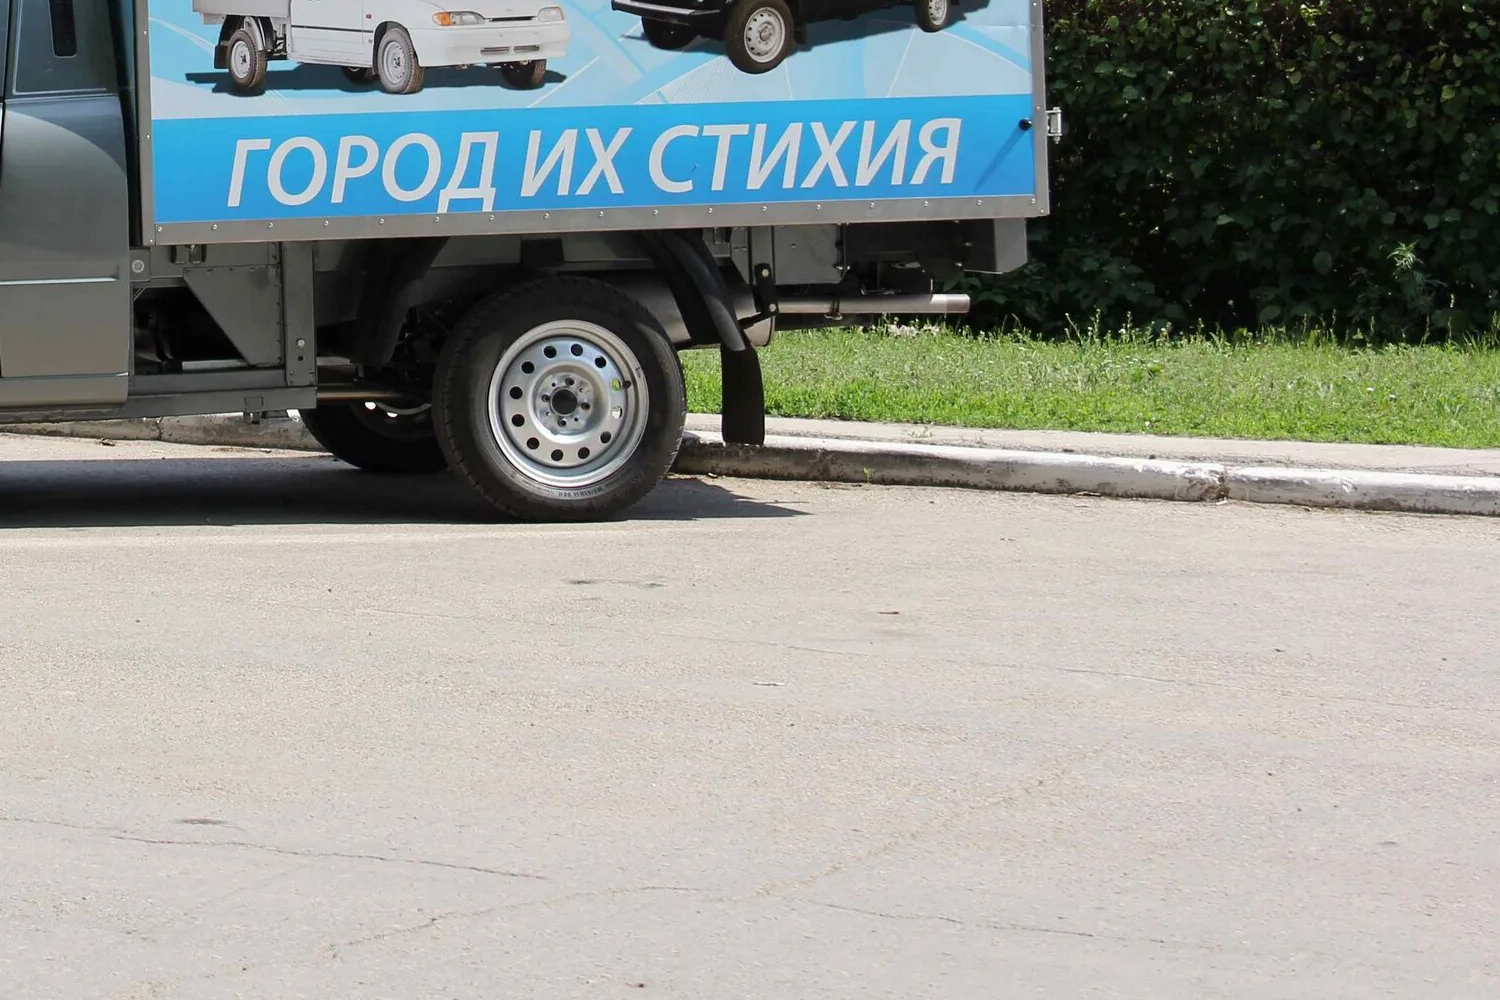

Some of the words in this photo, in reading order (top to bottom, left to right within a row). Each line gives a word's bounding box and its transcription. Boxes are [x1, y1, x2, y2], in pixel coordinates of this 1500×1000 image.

[226, 131, 500, 213] ГОРОД
[520, 127, 633, 197] ИХ
[648, 118, 962, 194] СТИХИЯ
